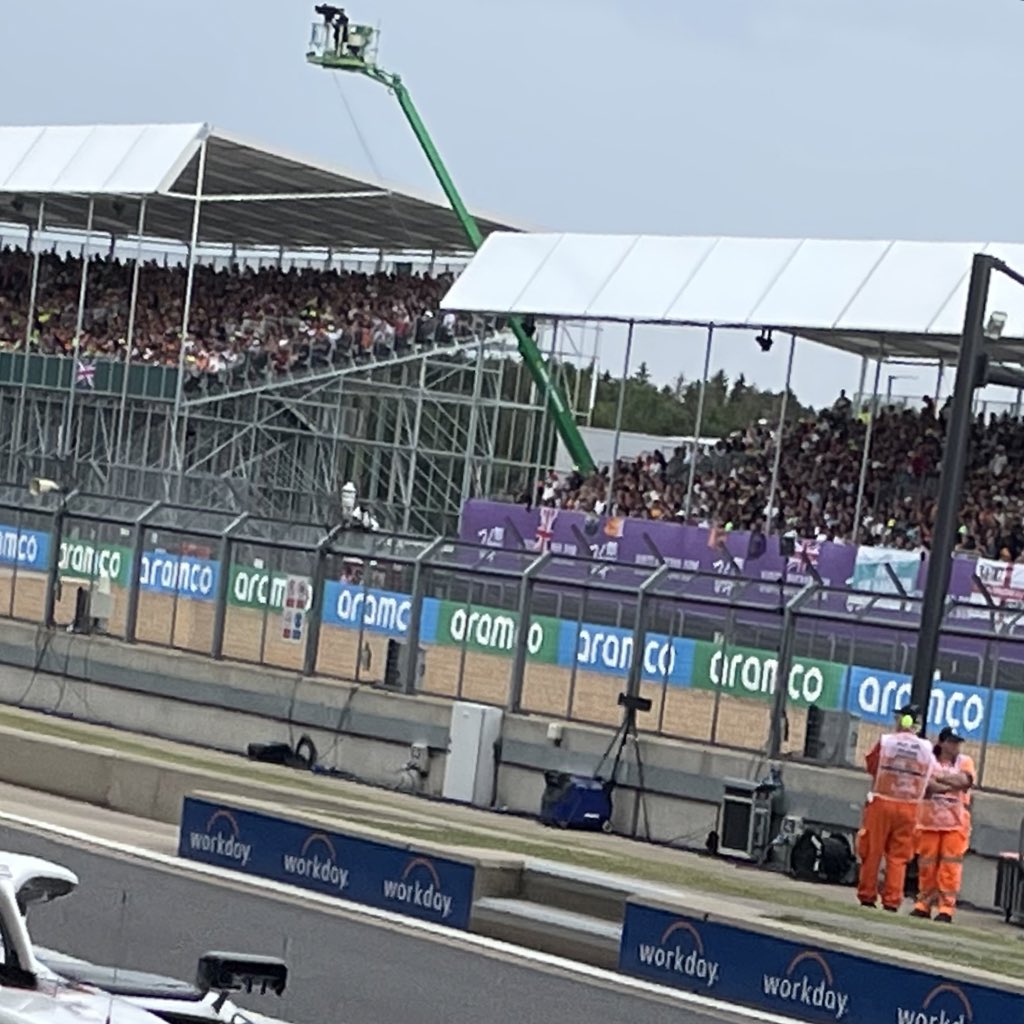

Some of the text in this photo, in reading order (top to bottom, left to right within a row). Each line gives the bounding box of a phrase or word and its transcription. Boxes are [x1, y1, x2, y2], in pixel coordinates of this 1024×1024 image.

[337, 588, 412, 632] aramc
[189, 829, 252, 867] workday
[283, 852, 350, 891] workday
[383, 876, 453, 918] workday
[638, 942, 720, 987] workday
[762, 972, 849, 1021] workday
